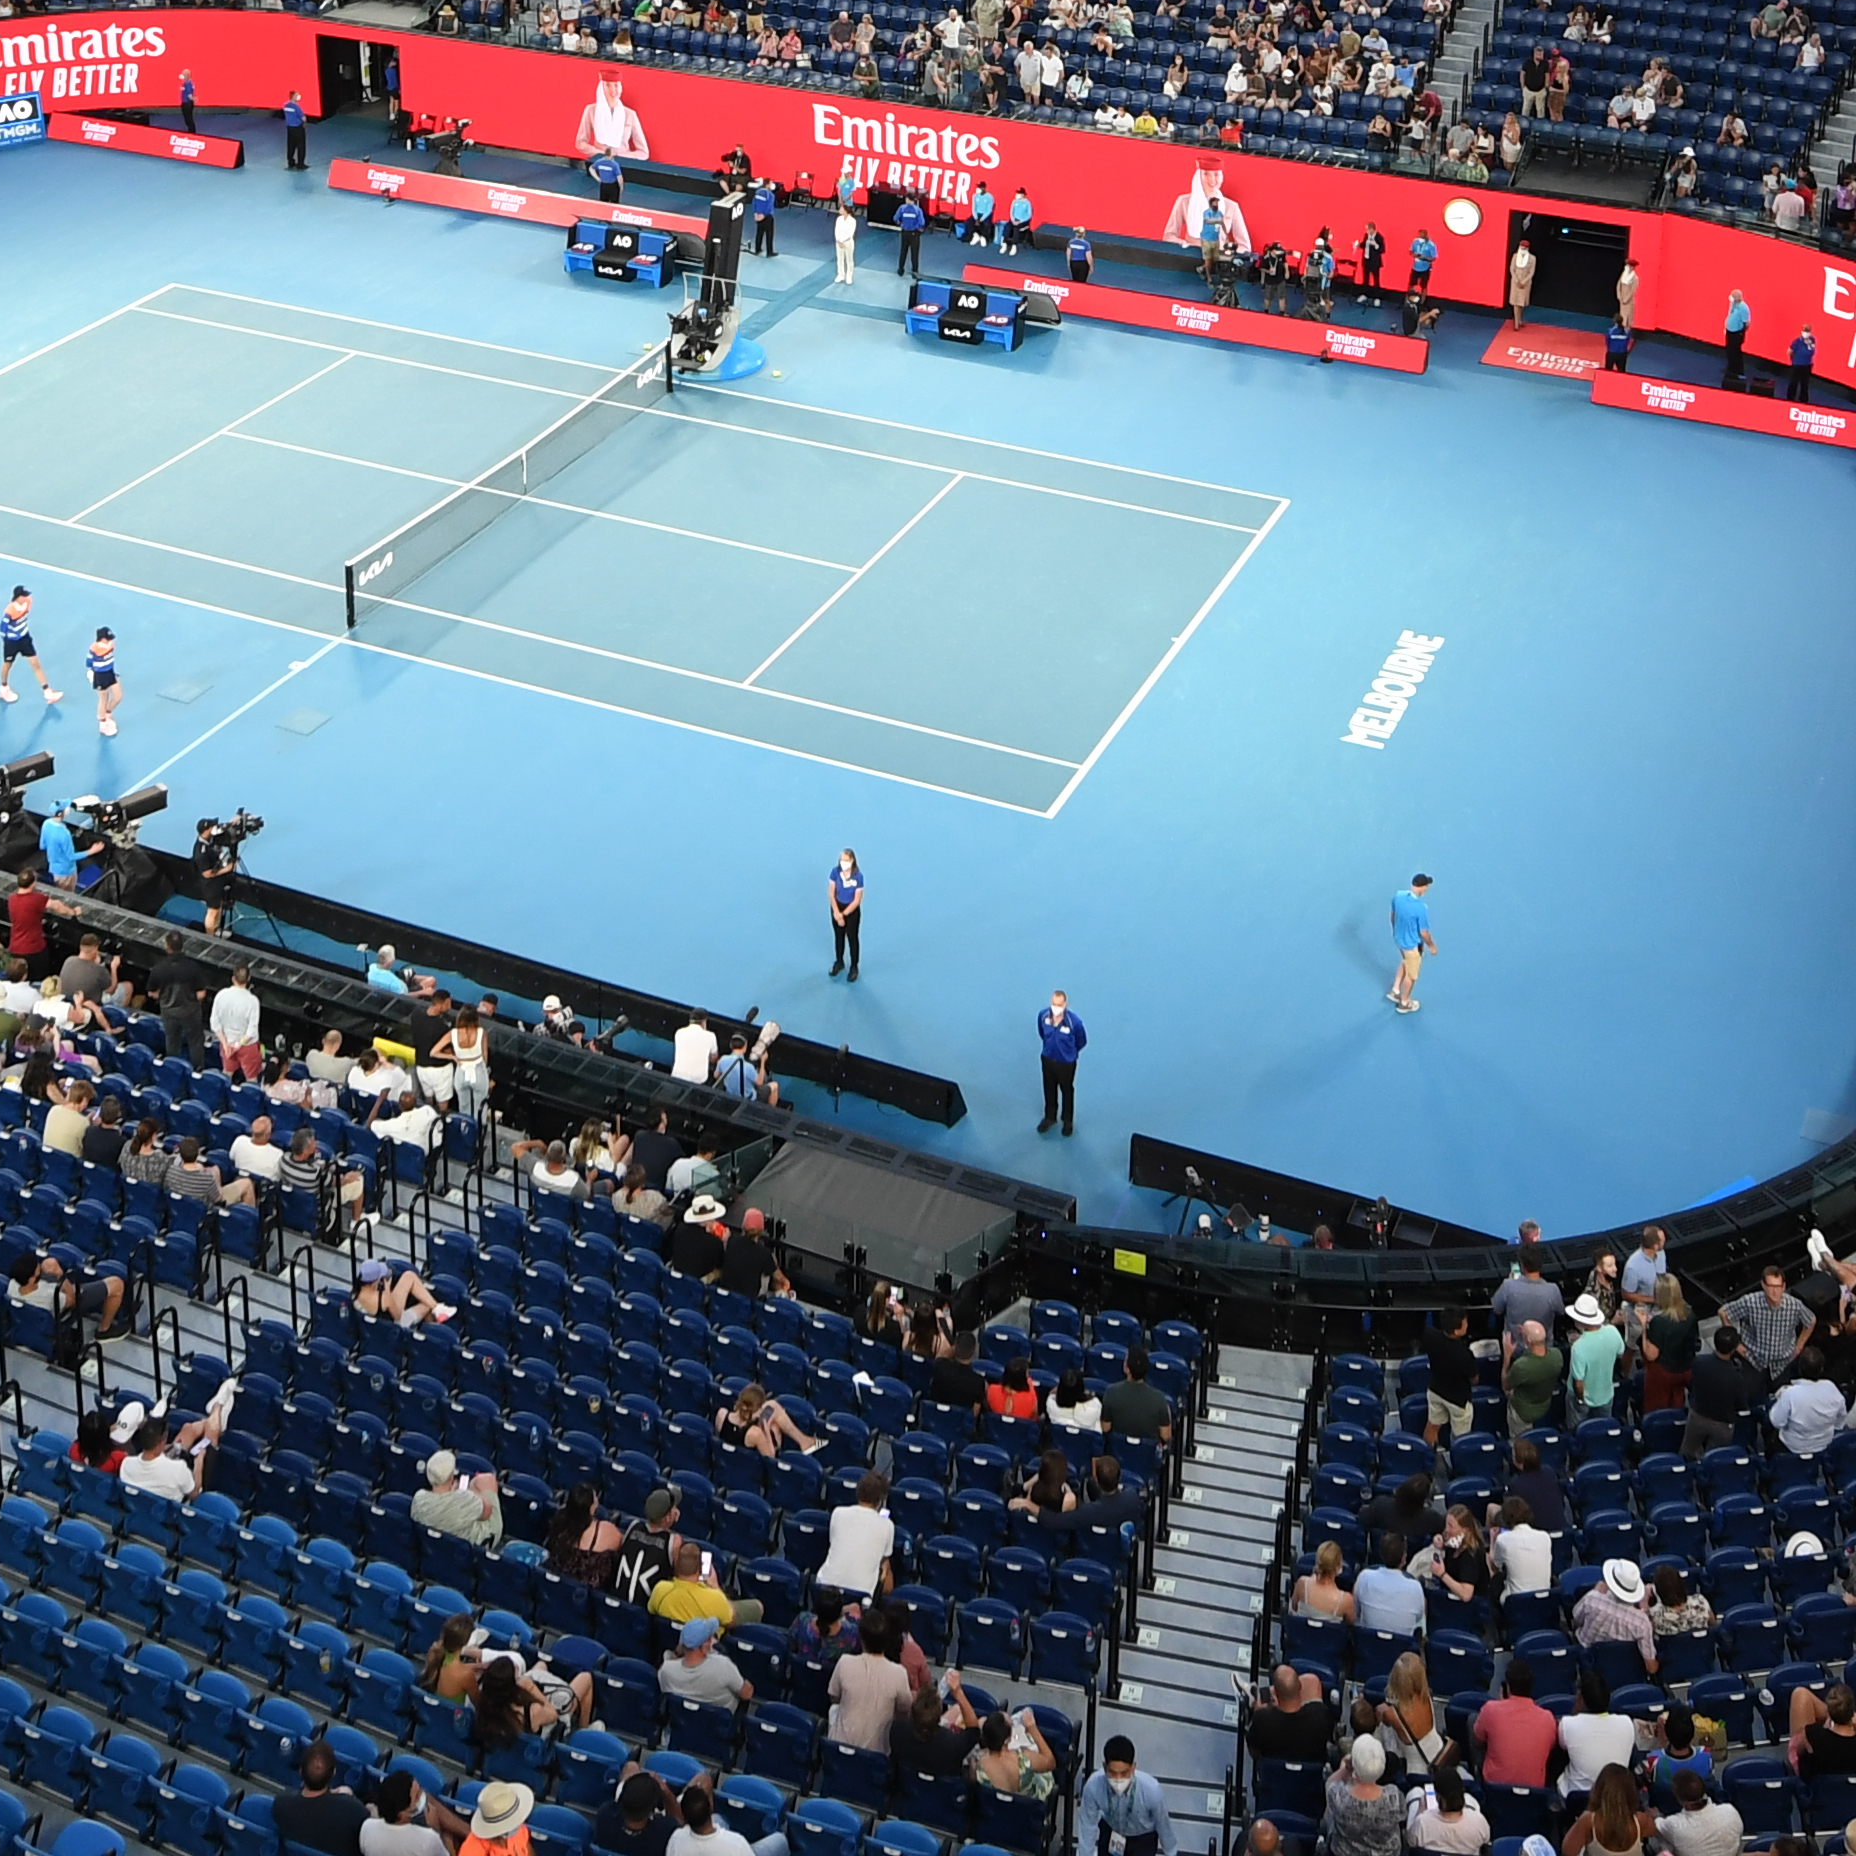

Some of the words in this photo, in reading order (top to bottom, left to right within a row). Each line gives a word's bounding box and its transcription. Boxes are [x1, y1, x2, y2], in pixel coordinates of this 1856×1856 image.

[51, 63, 140, 99] BETTER
[82, 122, 117, 135] Emirates
[812, 103, 1001, 170] Emirates
[170, 136, 206, 150] Emirates
[368, 170, 406, 186] Emirates
[488, 188, 527, 206] Emirates
[612, 235, 632, 249] AO
[1024, 278, 1070, 298] Emirates
[958, 295, 979, 309] AO
[1171, 304, 1220, 323] Emirates
[1326, 330, 1376, 350] Emirates
[1507, 346, 1601, 369] Emirates
[1516, 357, 1534, 366] FLY
[1536, 359, 1585, 374] BETTER
[1641, 381, 1696, 403] Emirates
[1647, 396, 1660, 407] FLY
[1660, 398, 1687, 412] BETTER
[1789, 407, 1846, 428] Emirates
[1795, 422, 1807, 432] FLY
[1808, 423, 1837, 437] BETTER
[1340, 629, 1446, 750] MELBOURNE
